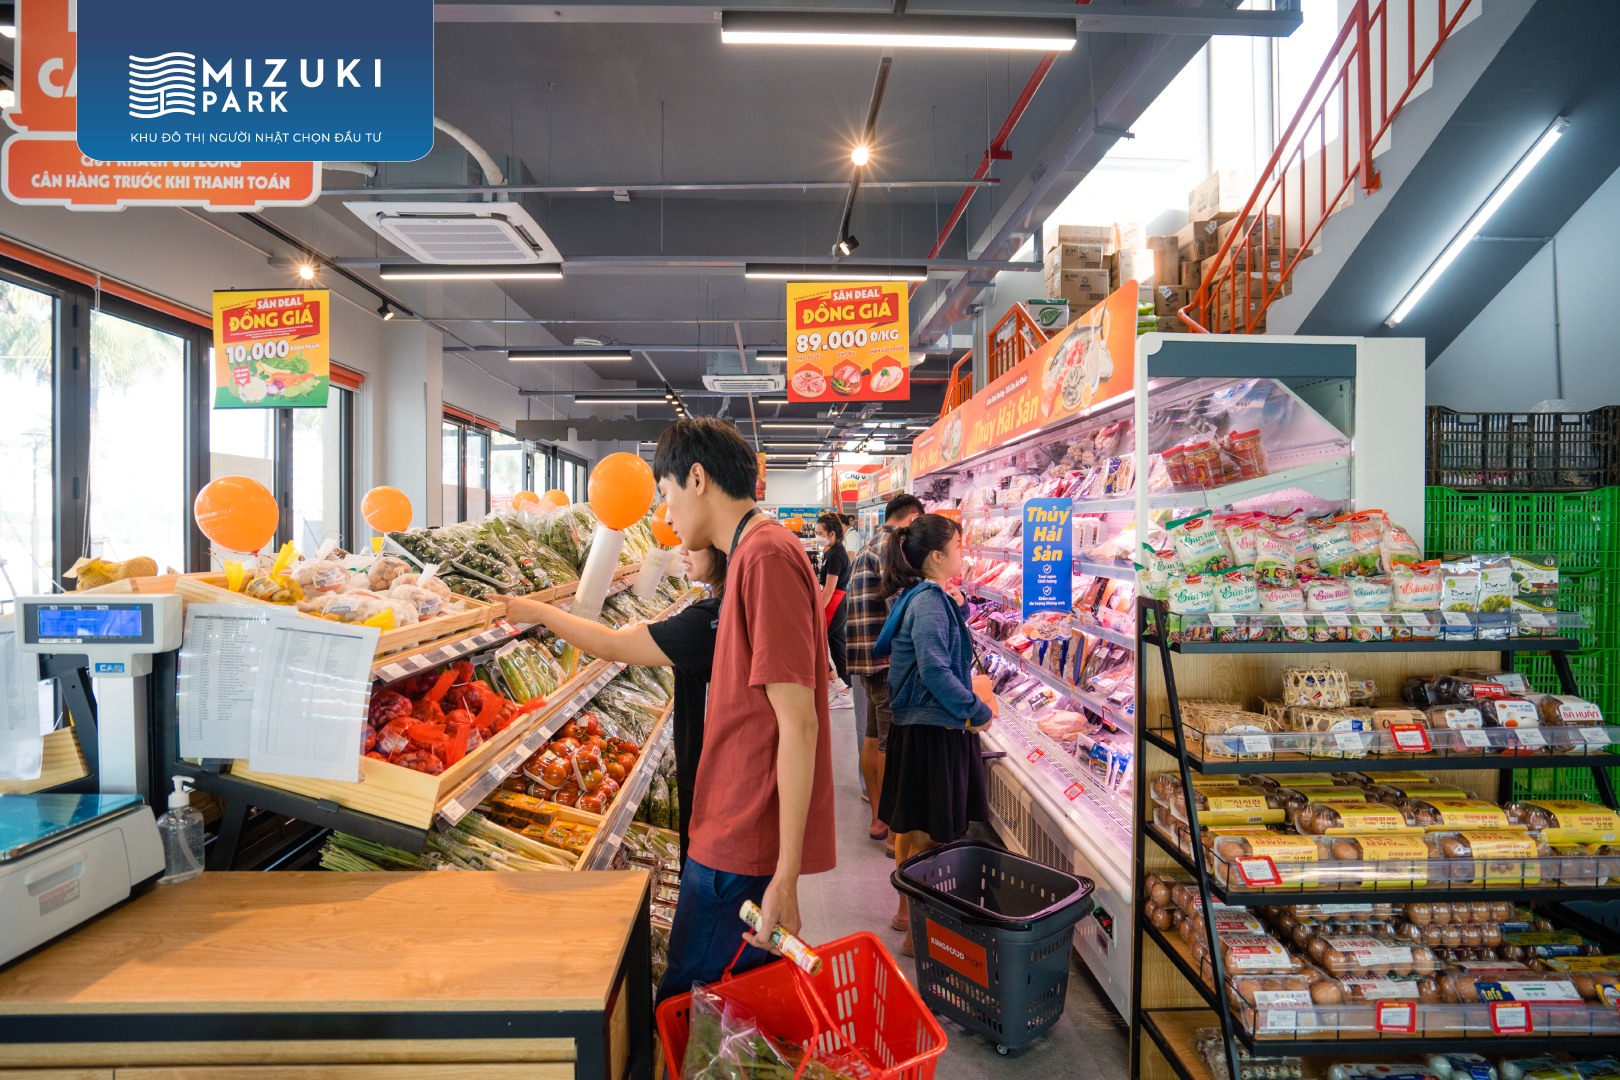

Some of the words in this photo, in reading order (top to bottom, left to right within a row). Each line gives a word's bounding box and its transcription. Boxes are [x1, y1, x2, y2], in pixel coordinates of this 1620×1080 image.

[31, 171, 62, 188] CÂN
[65, 171, 110, 189] HÀNG
[113, 171, 162, 189] TRƯỚC
[165, 175, 191, 189] KHI
[193, 175, 244, 189] THANH
[247, 172, 290, 189] TOÁN
[278, 296, 302, 308] DEAL
[855, 288, 880, 300] DEAL
[229, 308, 279, 332] ĐỒNG
[281, 304, 314, 325] GIÁ
[803, 301, 856, 324] ĐỒNG
[859, 298, 892, 319] GIÁ
[796, 328, 868, 353] 89.000
[225, 339, 290, 364] 10.000
[974, 412, 996, 446] Thủy
[996, 399, 1016, 437] Hải
[1016, 388, 1039, 429] Sản
[1026, 505, 1070, 525] Thủy
[1033, 525, 1063, 542] Hải
[1032, 544, 1063, 562] Sản
[1233, 799, 1261, 808] 신선란
[1481, 987, 1503, 1000] tafa
